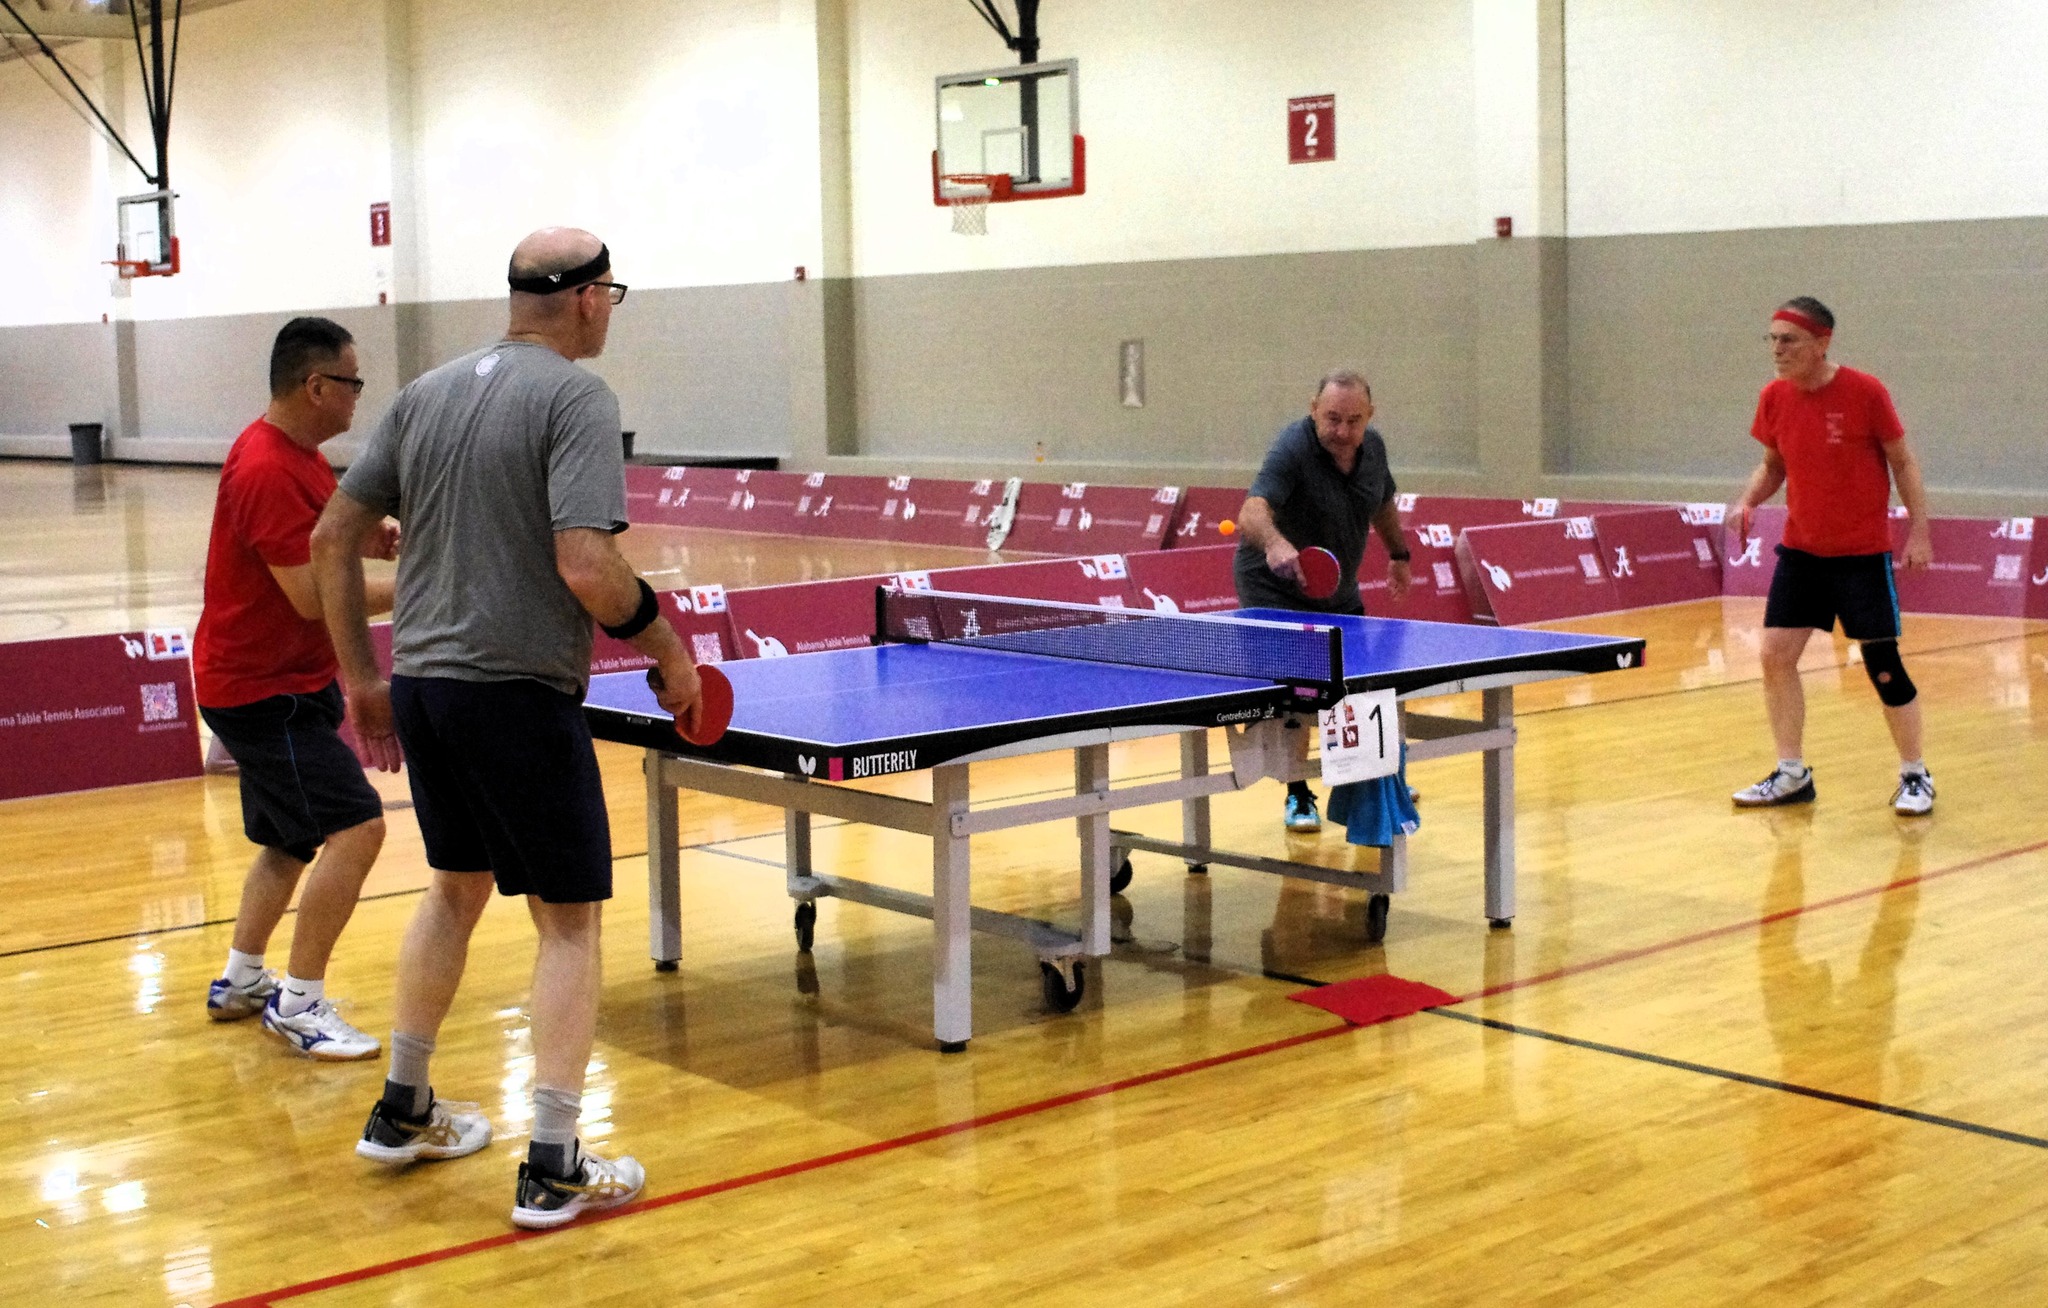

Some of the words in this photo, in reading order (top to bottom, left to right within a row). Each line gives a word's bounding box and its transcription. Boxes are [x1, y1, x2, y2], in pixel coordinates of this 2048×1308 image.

[1303, 112, 1319, 147] 2
[1612, 545, 1634, 578] A
[1728, 536, 1762, 567] A
[16, 711, 42, 726] Table
[43, 709, 73, 723] Tennis
[74, 703, 126, 720] Association
[1216, 709, 1252, 722] Centrefold
[1252, 707, 1261, 718] 25
[1368, 703, 1385, 759] 1
[853, 749, 917, 777] BUTTERFLY
